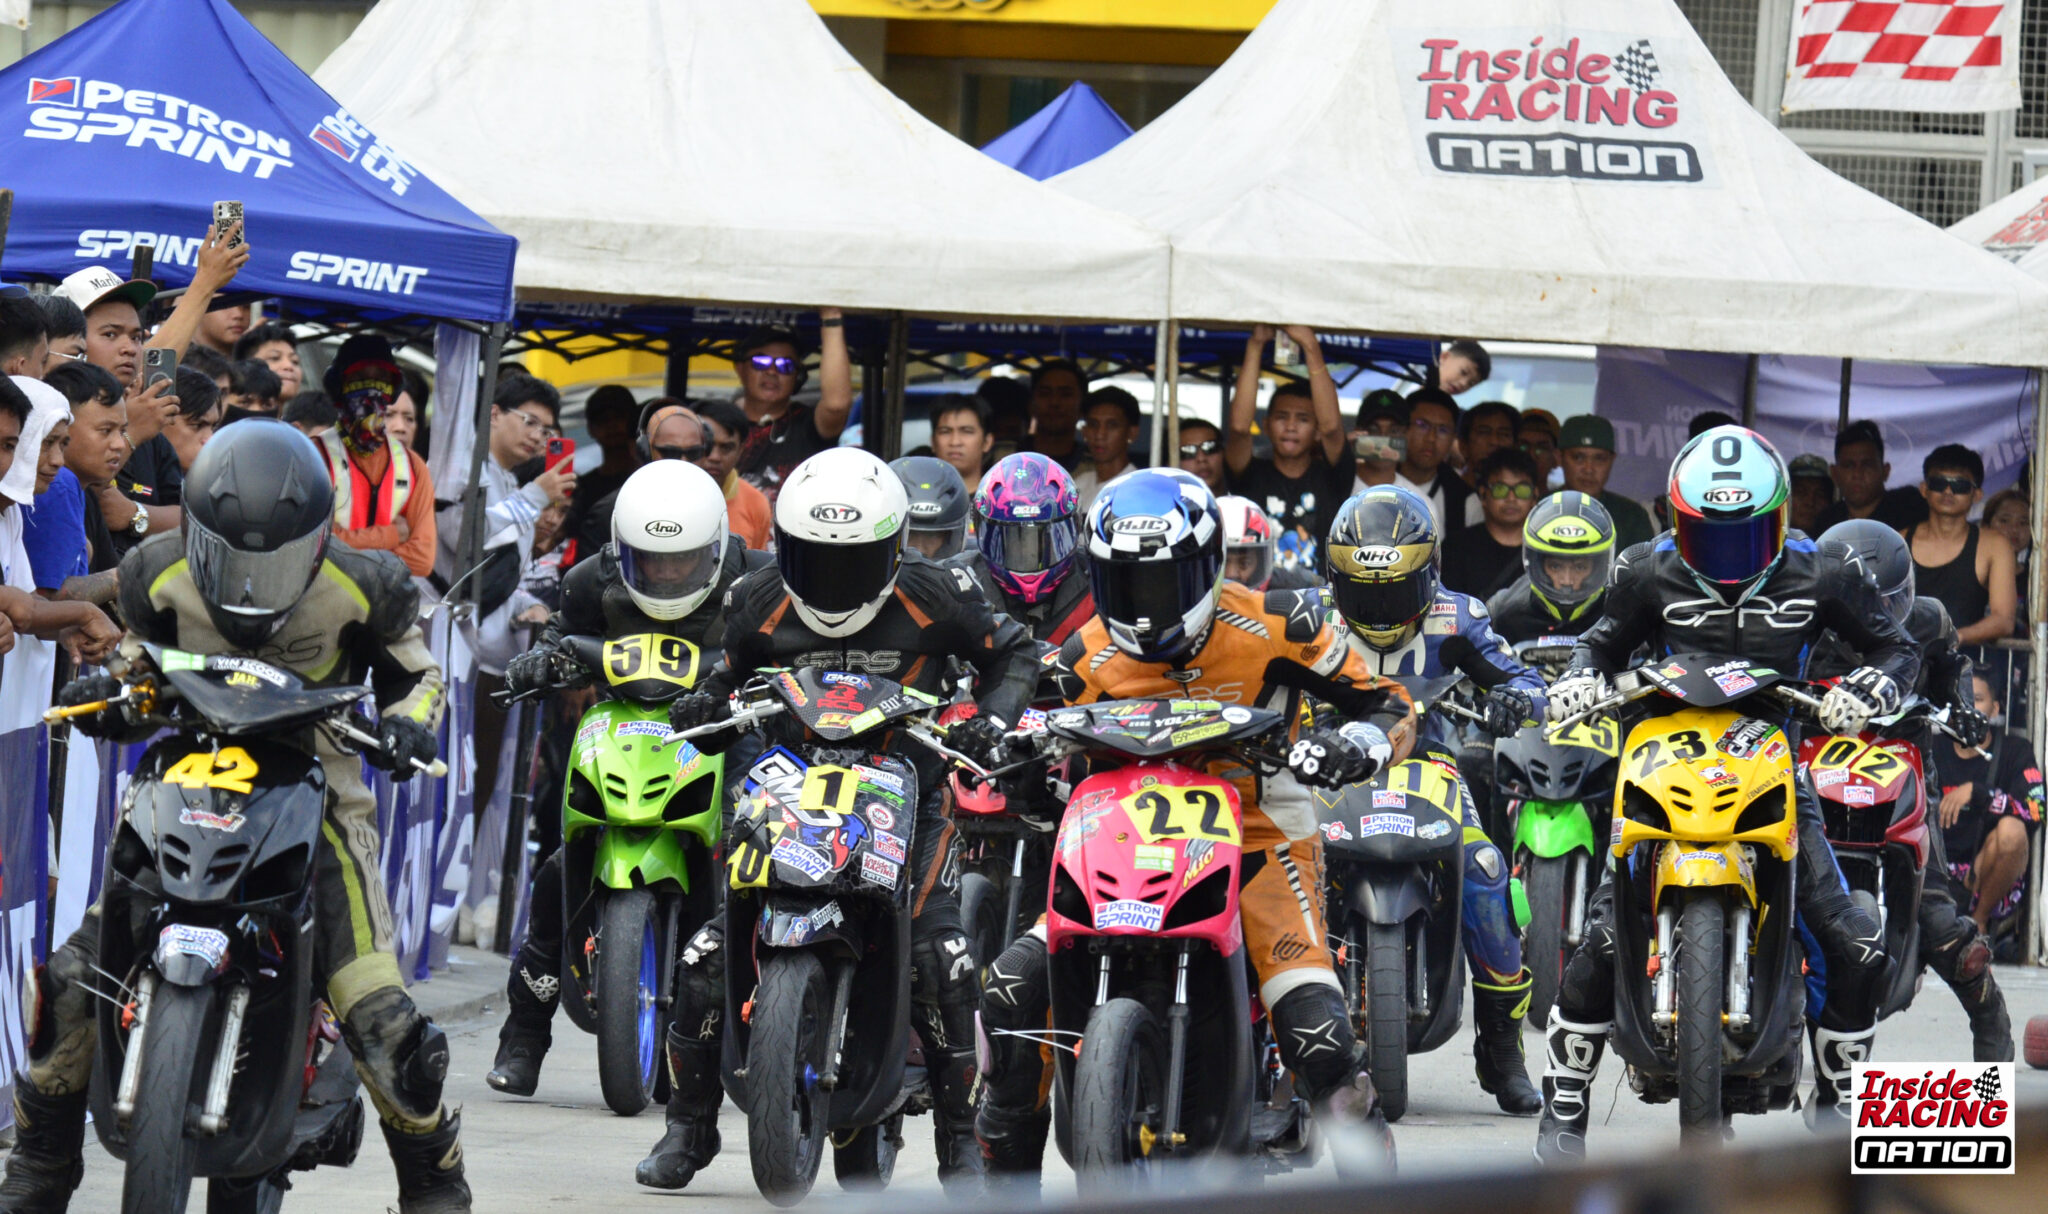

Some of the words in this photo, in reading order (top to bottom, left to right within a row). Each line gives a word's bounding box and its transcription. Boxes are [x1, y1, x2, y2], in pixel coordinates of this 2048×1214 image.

[1417, 36, 1611, 84] Inside
[1425, 79, 1679, 128] RACING
[84, 80, 292, 157] PETRON
[24, 107, 294, 179] SPRINT
[1439, 137, 1691, 178] NATION
[286, 251, 428, 296] SPRINT
[1707, 489, 1749, 502] KYT
[648, 521, 679, 534] Arai
[814, 508, 855, 520] KYT
[1117, 519, 1164, 532] HJC
[1556, 527, 1580, 536] KYT
[1357, 549, 1395, 562] NHK
[610, 637, 691, 679] 59
[825, 673, 862, 685] GMD
[617, 728, 672, 737] SPRINT
[629, 721, 673, 731] PETRON
[1632, 730, 1707, 779] 23
[1820, 741, 1898, 781] 02
[163, 746, 260, 794] 42
[818, 771, 844, 808] 1
[1135, 789, 1231, 838] 22
[1372, 815, 1413, 825] PETRON
[1362, 822, 1413, 836] SPRINT
[771, 848, 825, 877] SPRINT
[790, 840, 830, 871] PETRON
[1097, 912, 1161, 930] SPRINT
[1108, 902, 1161, 916] PETRON
